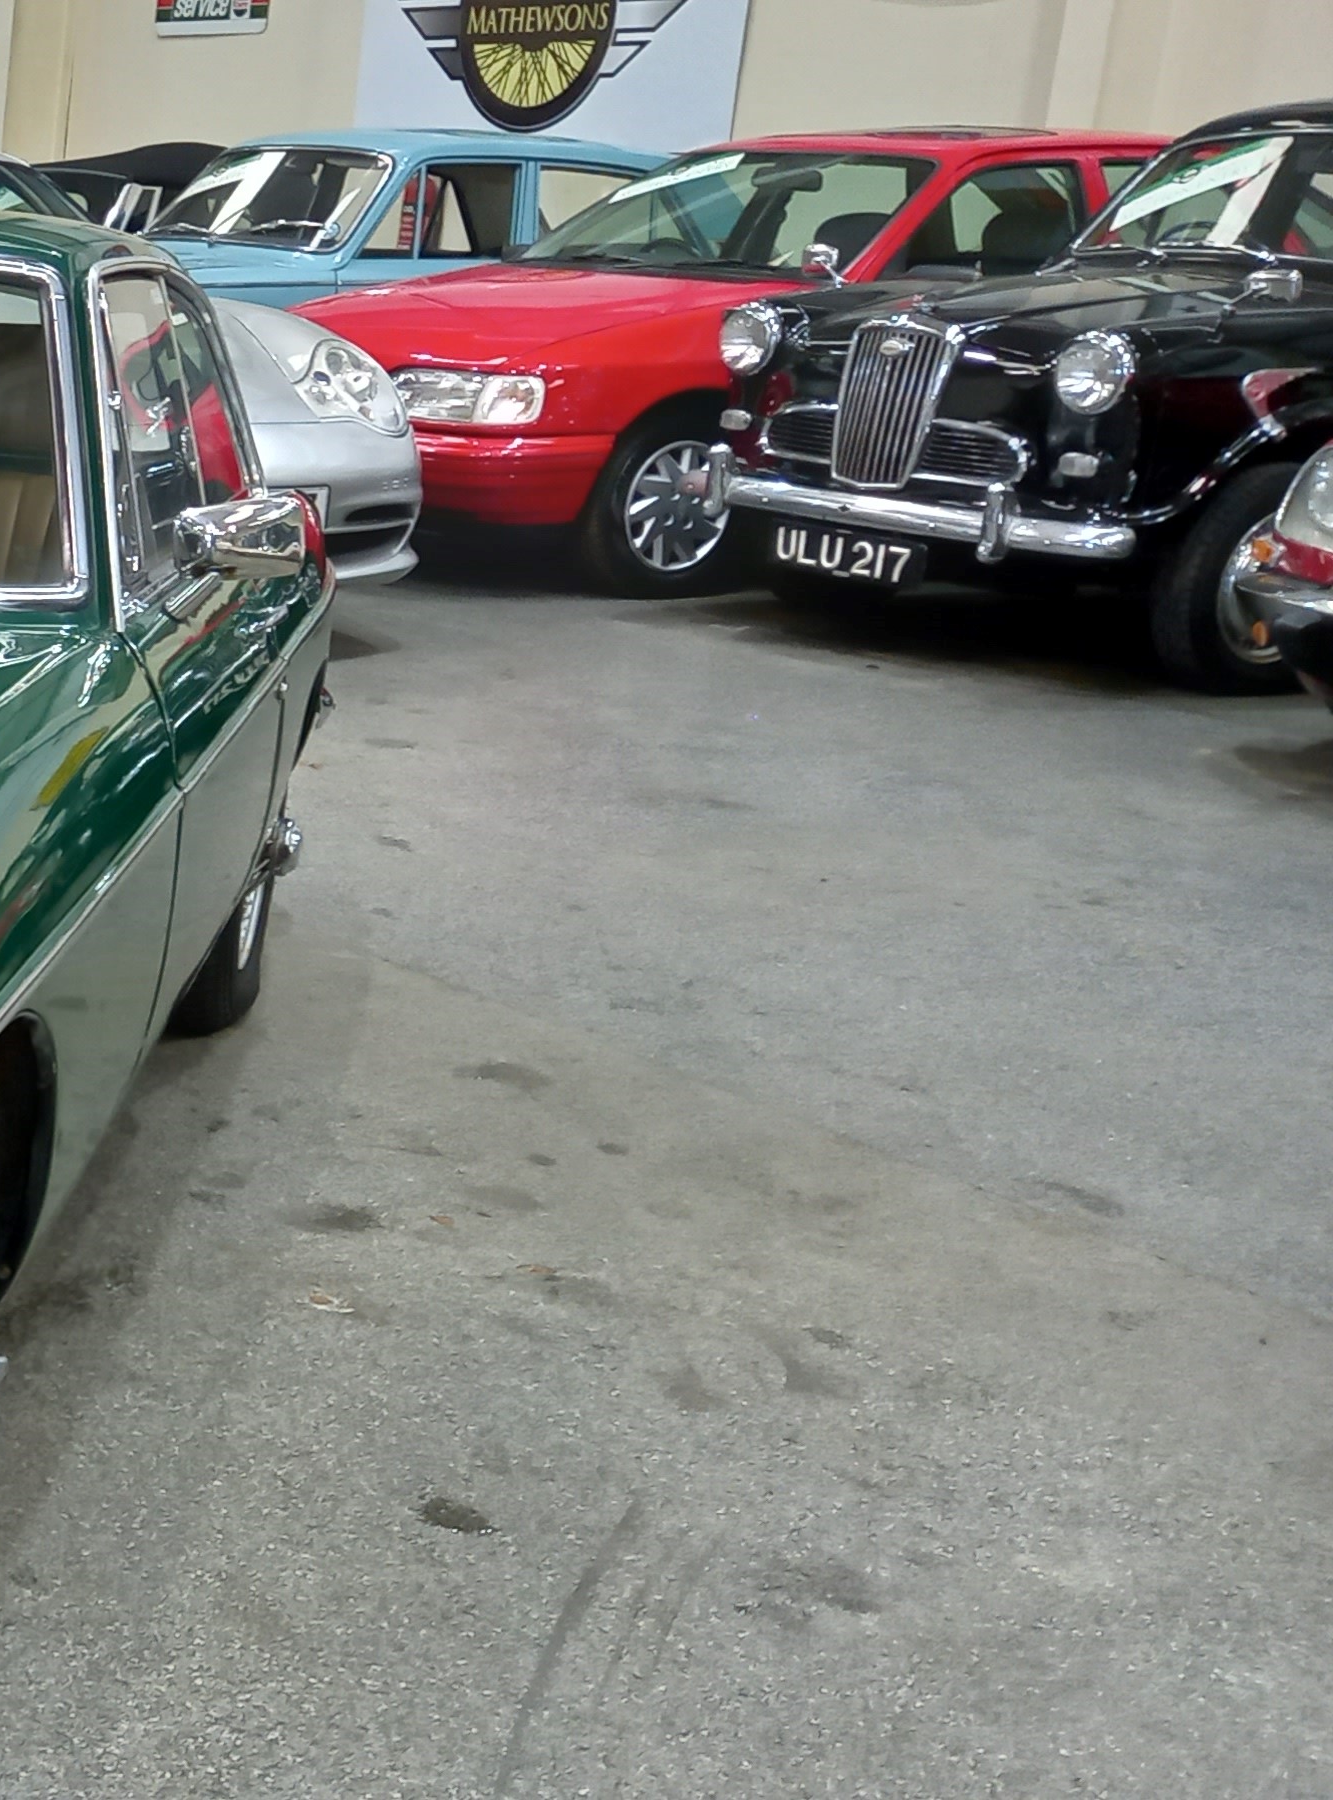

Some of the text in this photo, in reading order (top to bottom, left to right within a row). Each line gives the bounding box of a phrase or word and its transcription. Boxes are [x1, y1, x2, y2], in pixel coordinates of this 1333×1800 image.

[466, 2, 610, 35] MATHEWSONS
[776, 526, 912, 583] ULU 217
